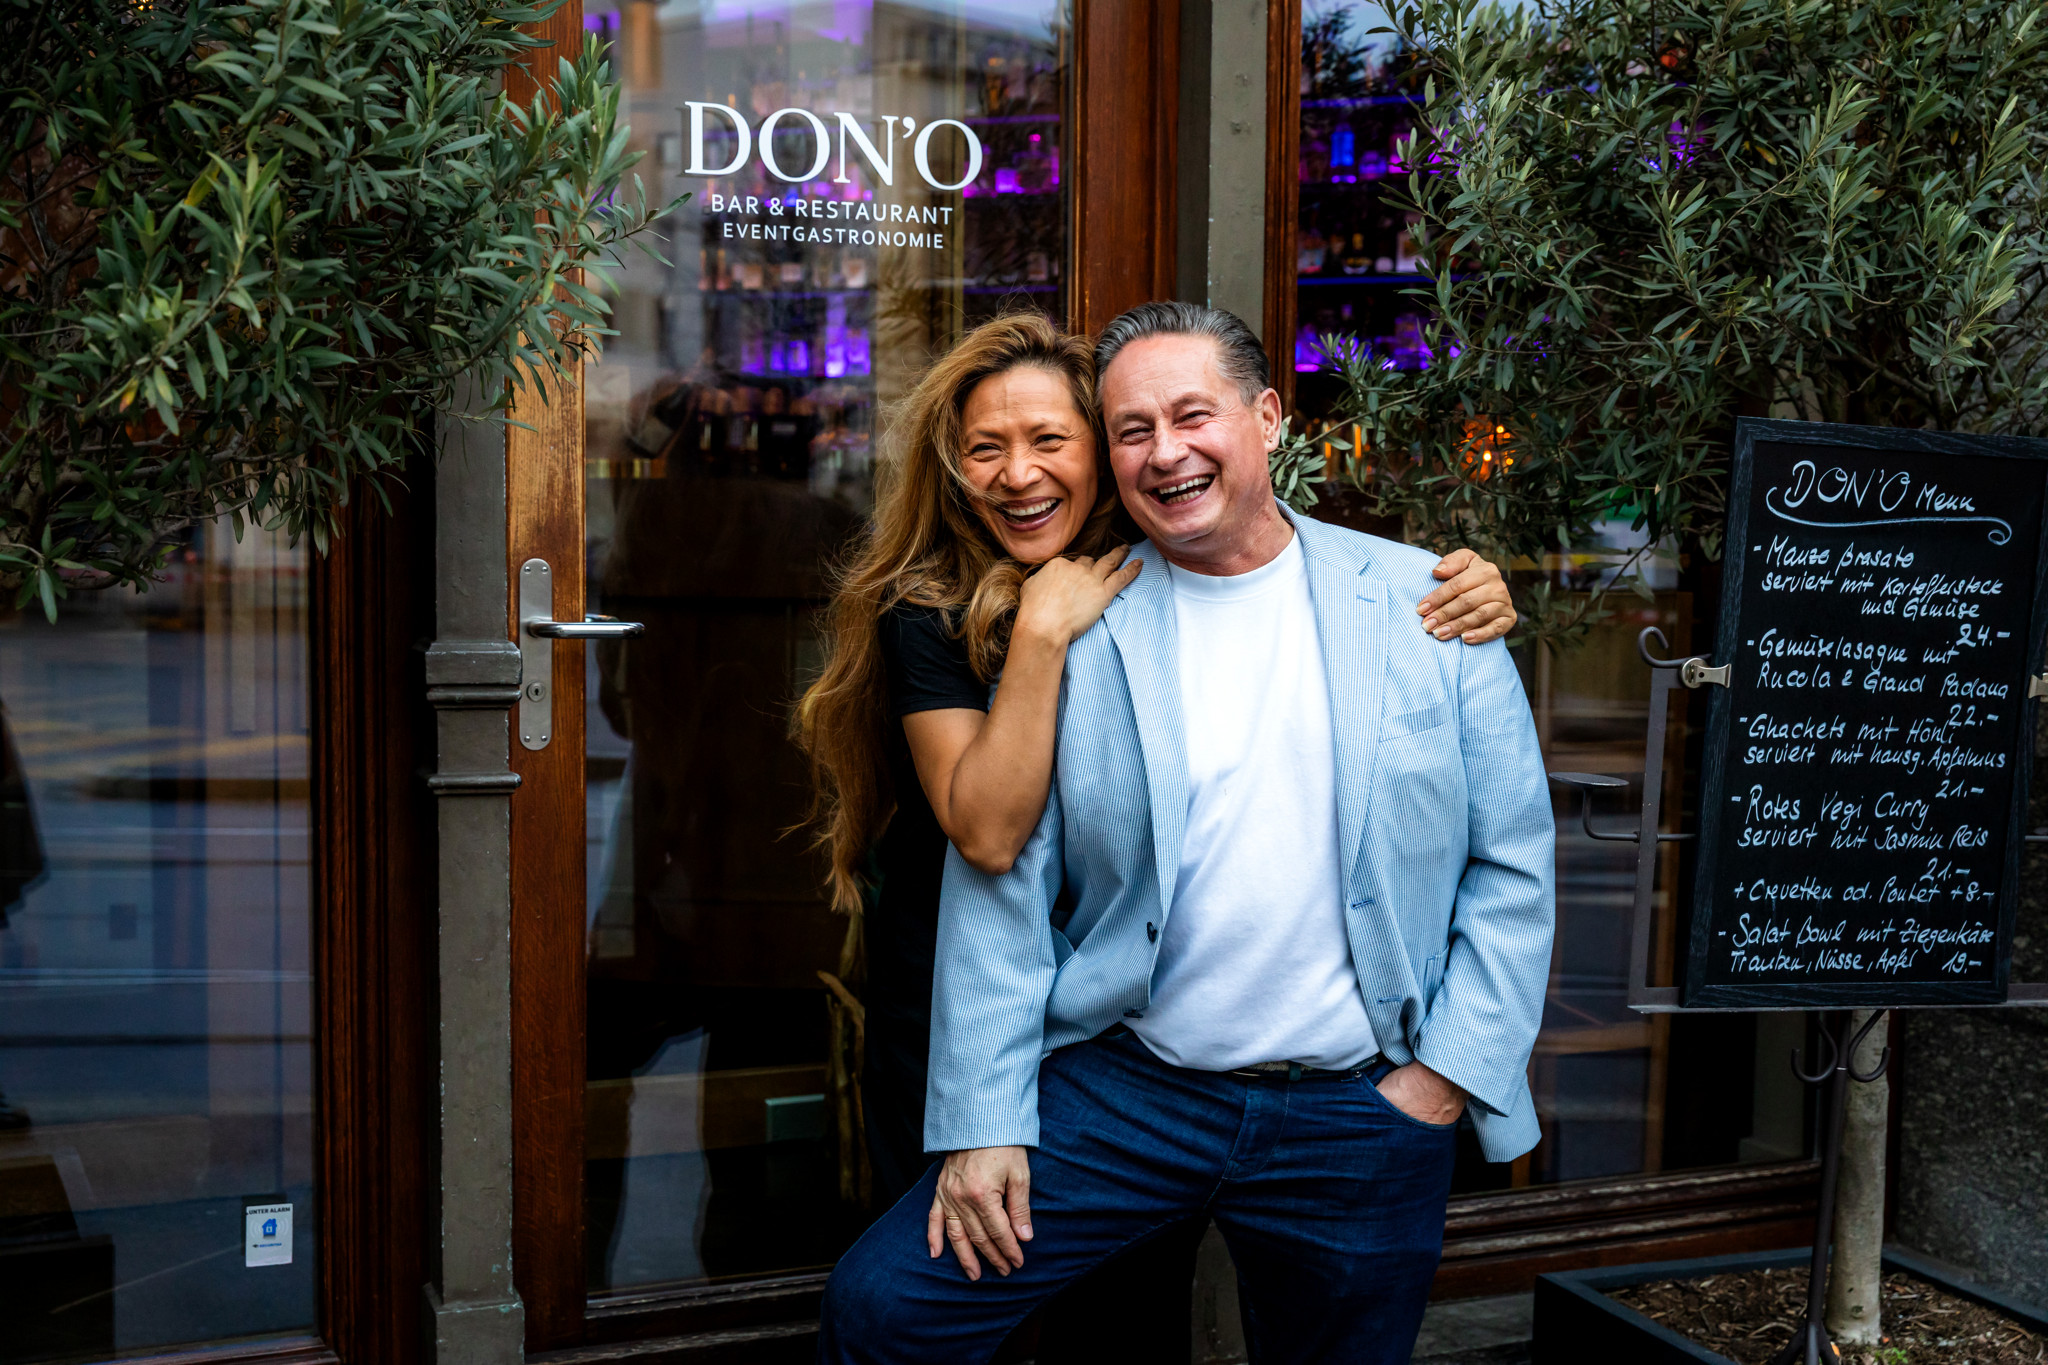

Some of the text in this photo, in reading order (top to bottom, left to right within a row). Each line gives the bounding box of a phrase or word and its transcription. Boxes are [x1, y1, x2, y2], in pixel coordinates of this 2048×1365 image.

[684, 101, 983, 191] DON'O
[711, 194, 953, 225] BAR & RESTAURANT
[723, 222, 944, 249] EVENTGASTRONOMIE
[1761, 571, 1834, 592] serviert
[1840, 572, 1874, 594] mit
[1861, 597, 1980, 621] und Gemüse
[1759, 628, 1908, 671] Gemüselasagne
[1922, 640, 1960, 664] mit
[1857, 716, 1900, 742] mit
[1949, 703, 1999, 727] 22.-
[1743, 743, 1815, 764] serviert
[1830, 744, 1864, 765] mit
[1928, 746, 2006, 776] Apfelmus
[1746, 784, 1800, 824] Rotes
[1820, 791, 1864, 830] Vegi
[1875, 791, 1930, 831] Curry
[1737, 822, 1989, 850] serviert mit Jasmin Reis
[1732, 913, 1791, 947] Salat
[1856, 919, 1896, 943] mit
[1899, 918, 1995, 952] Ziegenkäse
